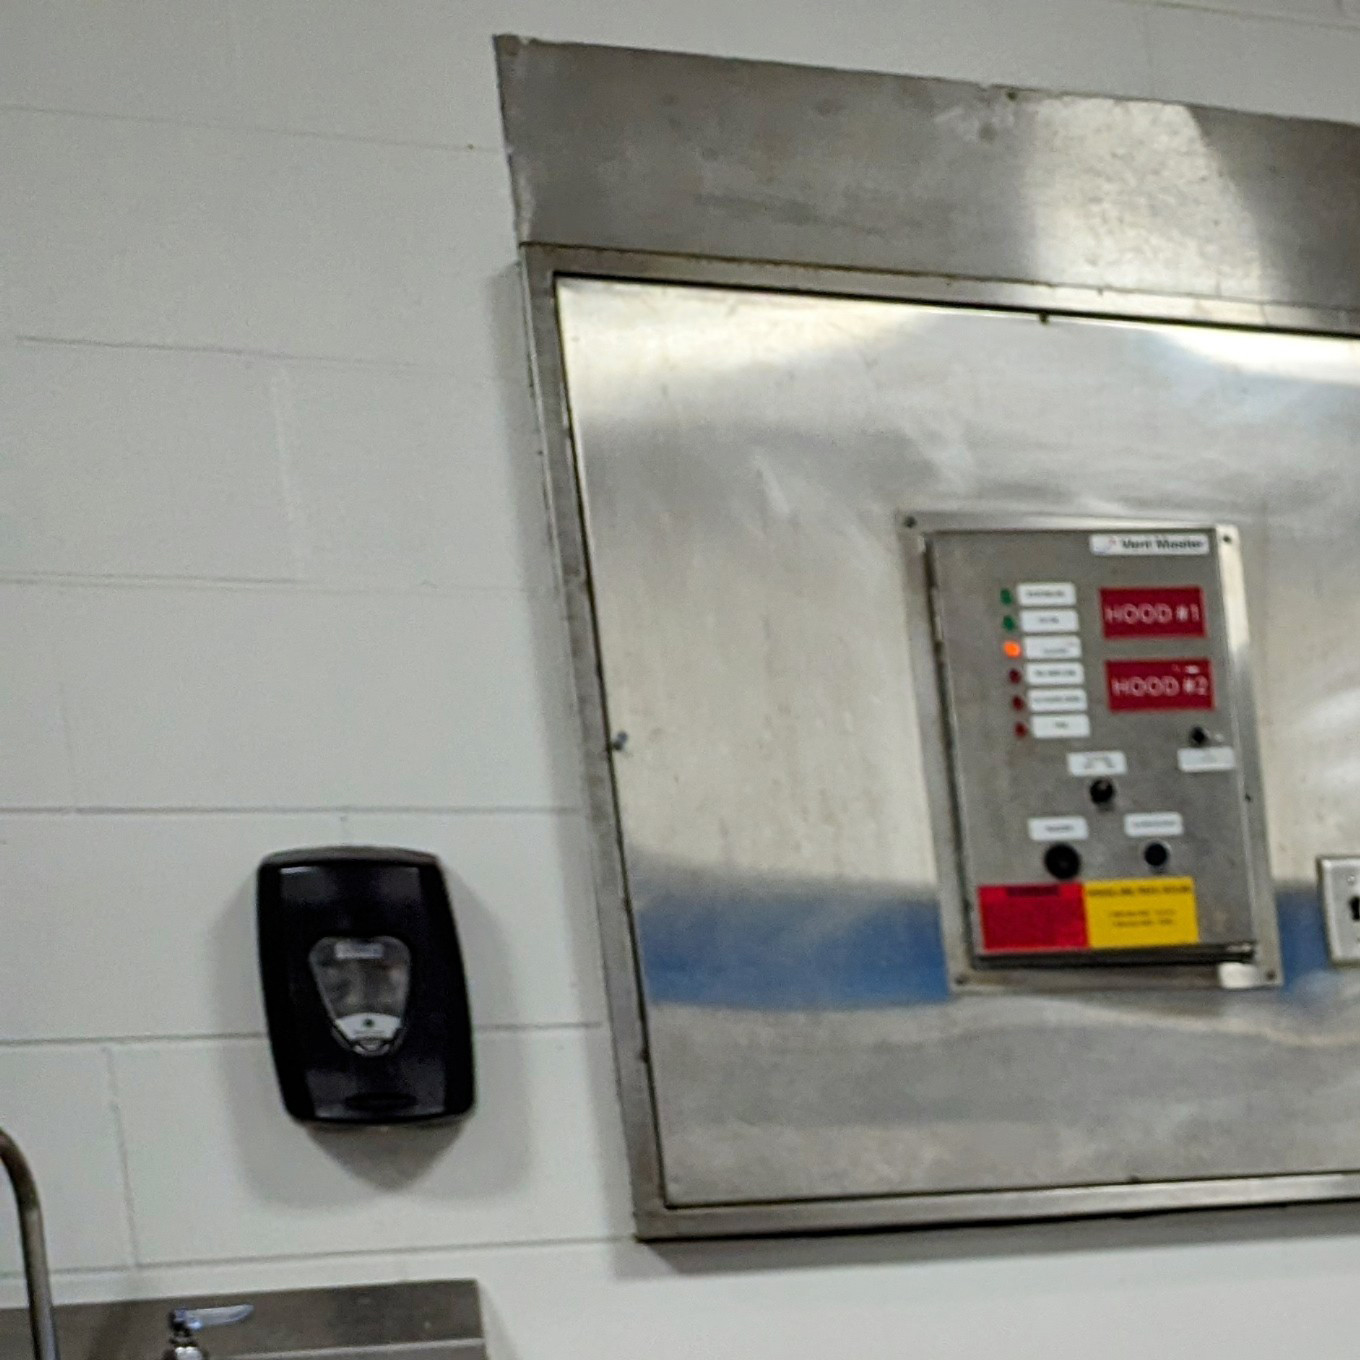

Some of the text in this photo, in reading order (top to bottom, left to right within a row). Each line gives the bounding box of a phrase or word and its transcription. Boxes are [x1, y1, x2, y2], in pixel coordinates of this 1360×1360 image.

[1104, 603, 1200, 624] HOOD #1
[1111, 675, 1209, 697] HOOD #2
